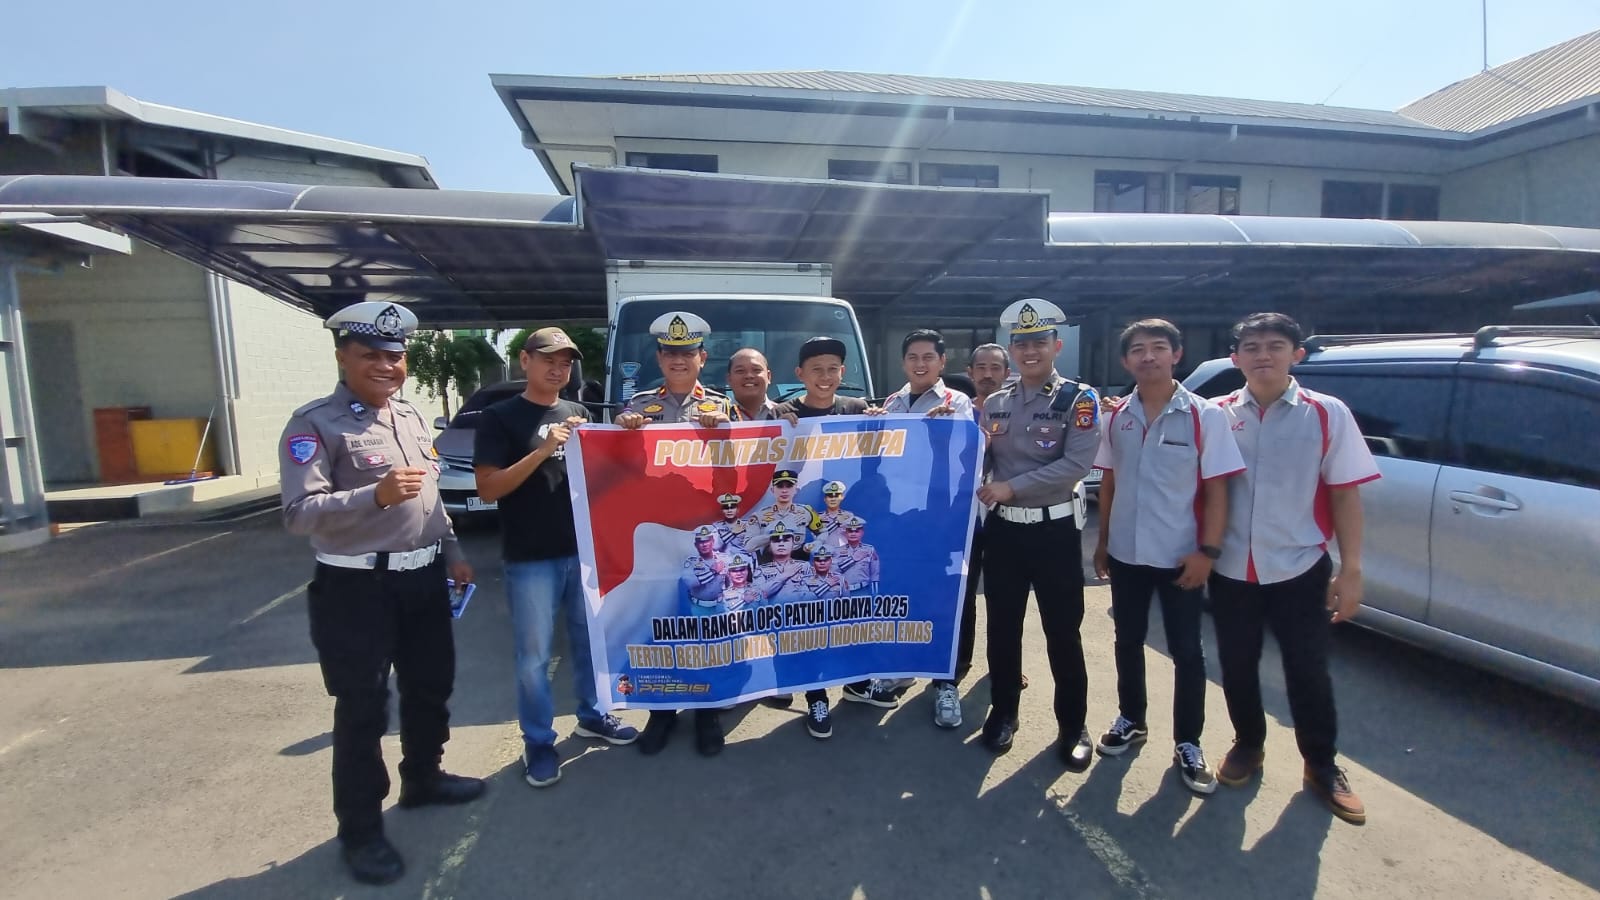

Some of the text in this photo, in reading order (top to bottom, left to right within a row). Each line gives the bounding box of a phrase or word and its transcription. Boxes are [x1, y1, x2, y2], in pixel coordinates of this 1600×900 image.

[1033, 412, 1063, 420] POLRI
[654, 429, 907, 467] POLANTAS MENYAPA
[652, 595, 909, 642] DALAM RANGKA OPS PATUH LODAYA 2025
[626, 621, 934, 670] TERTIB BERLALU LINTAS MENUJU INDONESIA EMAS
[639, 683, 711, 693] PRESISI
